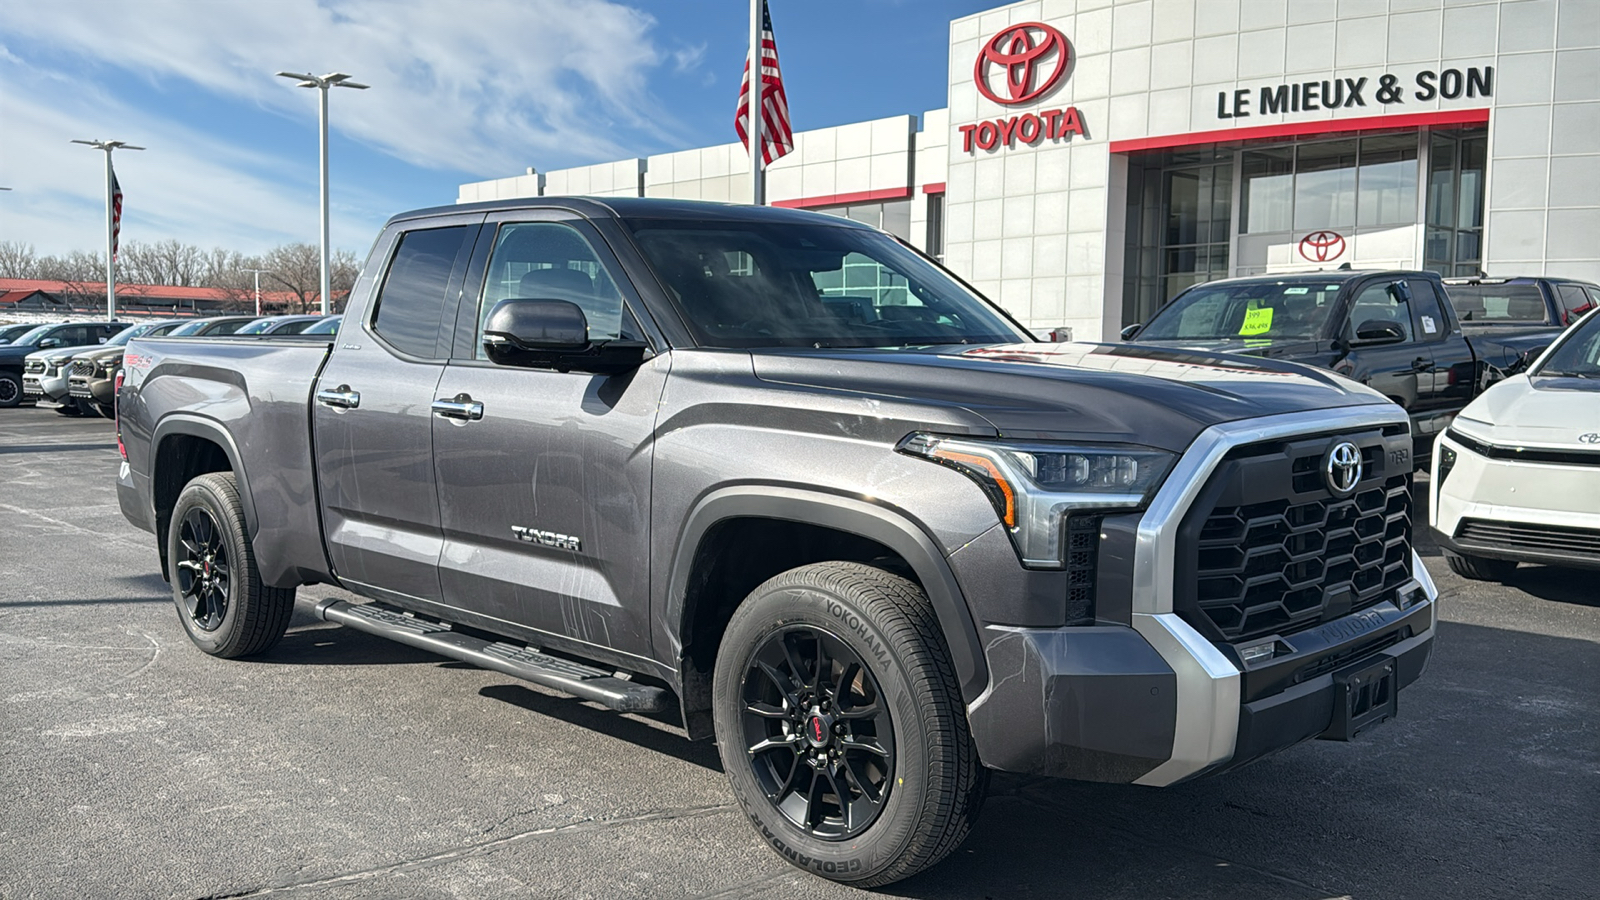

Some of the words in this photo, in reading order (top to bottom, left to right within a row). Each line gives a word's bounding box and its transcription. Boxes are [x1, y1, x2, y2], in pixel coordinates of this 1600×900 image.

[1218, 89, 1251, 119] LE
[1259, 77, 1368, 115] MIEUX
[1375, 74, 1403, 105] &
[1415, 66, 1494, 102] SON
[958, 106, 1085, 153] TOYOTA
[1389, 448, 1409, 465] TRD
[511, 525, 582, 552] TUNDRA
[826, 599, 892, 672] YOKOHAMA
[750, 813, 863, 874] GEOLANDAR
